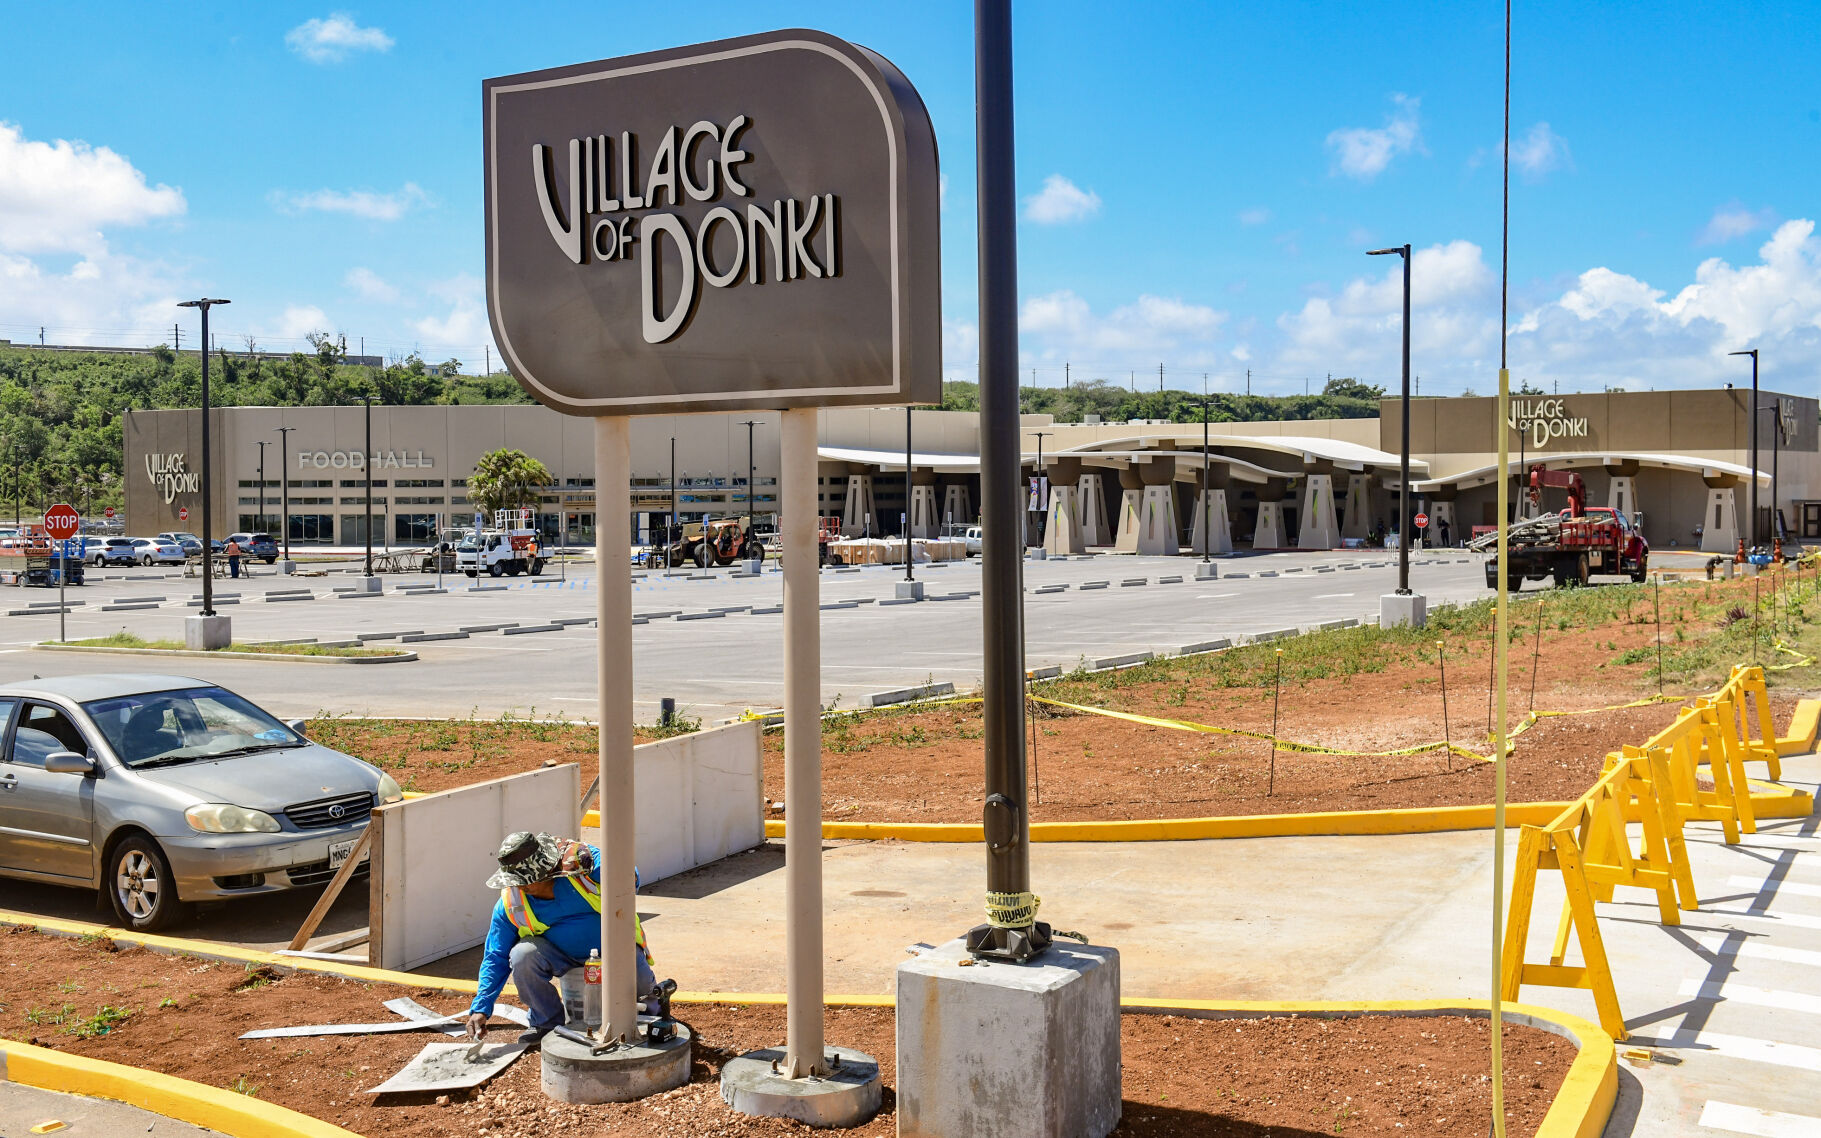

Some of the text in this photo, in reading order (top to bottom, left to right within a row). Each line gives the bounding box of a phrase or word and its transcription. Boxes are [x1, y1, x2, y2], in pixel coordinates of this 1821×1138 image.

[532, 114, 747, 264] VILLAGE
[592, 194, 838, 344] OF DONKI
[1520, 418, 1587, 448] OF DONKI
[145, 453, 184, 484] VILLAGE
[298, 451, 365, 469] FOOD
[156, 473, 199, 504] OF DONKI
[46, 515, 77, 529] STOP
